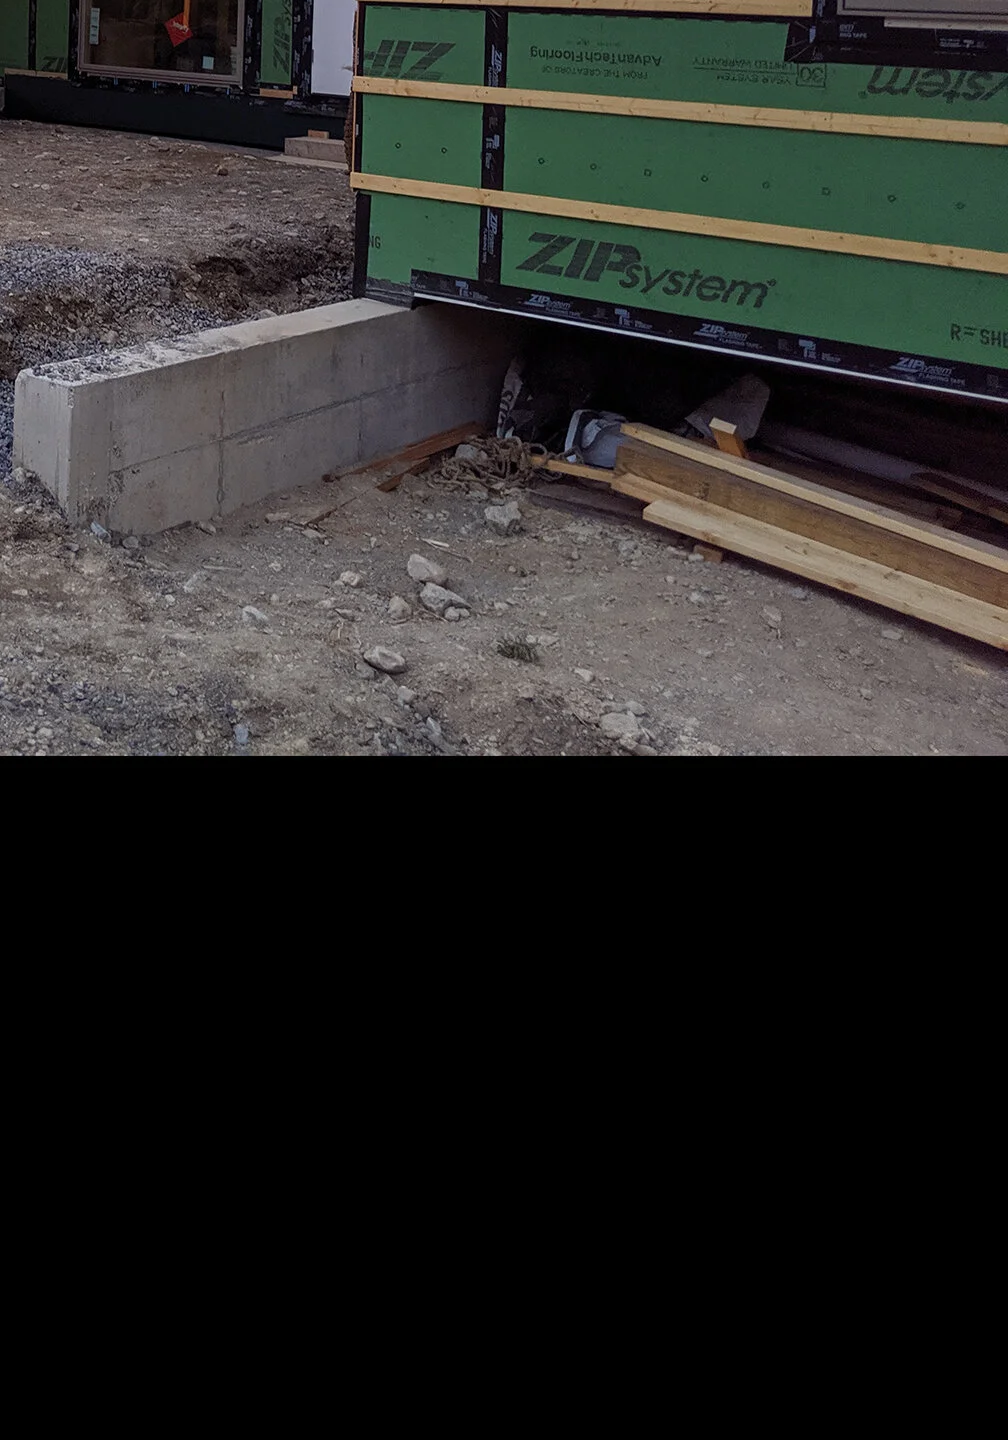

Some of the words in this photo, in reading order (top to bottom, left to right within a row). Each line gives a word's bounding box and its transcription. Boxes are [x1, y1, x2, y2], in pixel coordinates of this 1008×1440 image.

[692, 57, 751, 68] WARRANTY
[800, 66, 824, 83] 30
[515, 231, 769, 310] ZIPsystem
